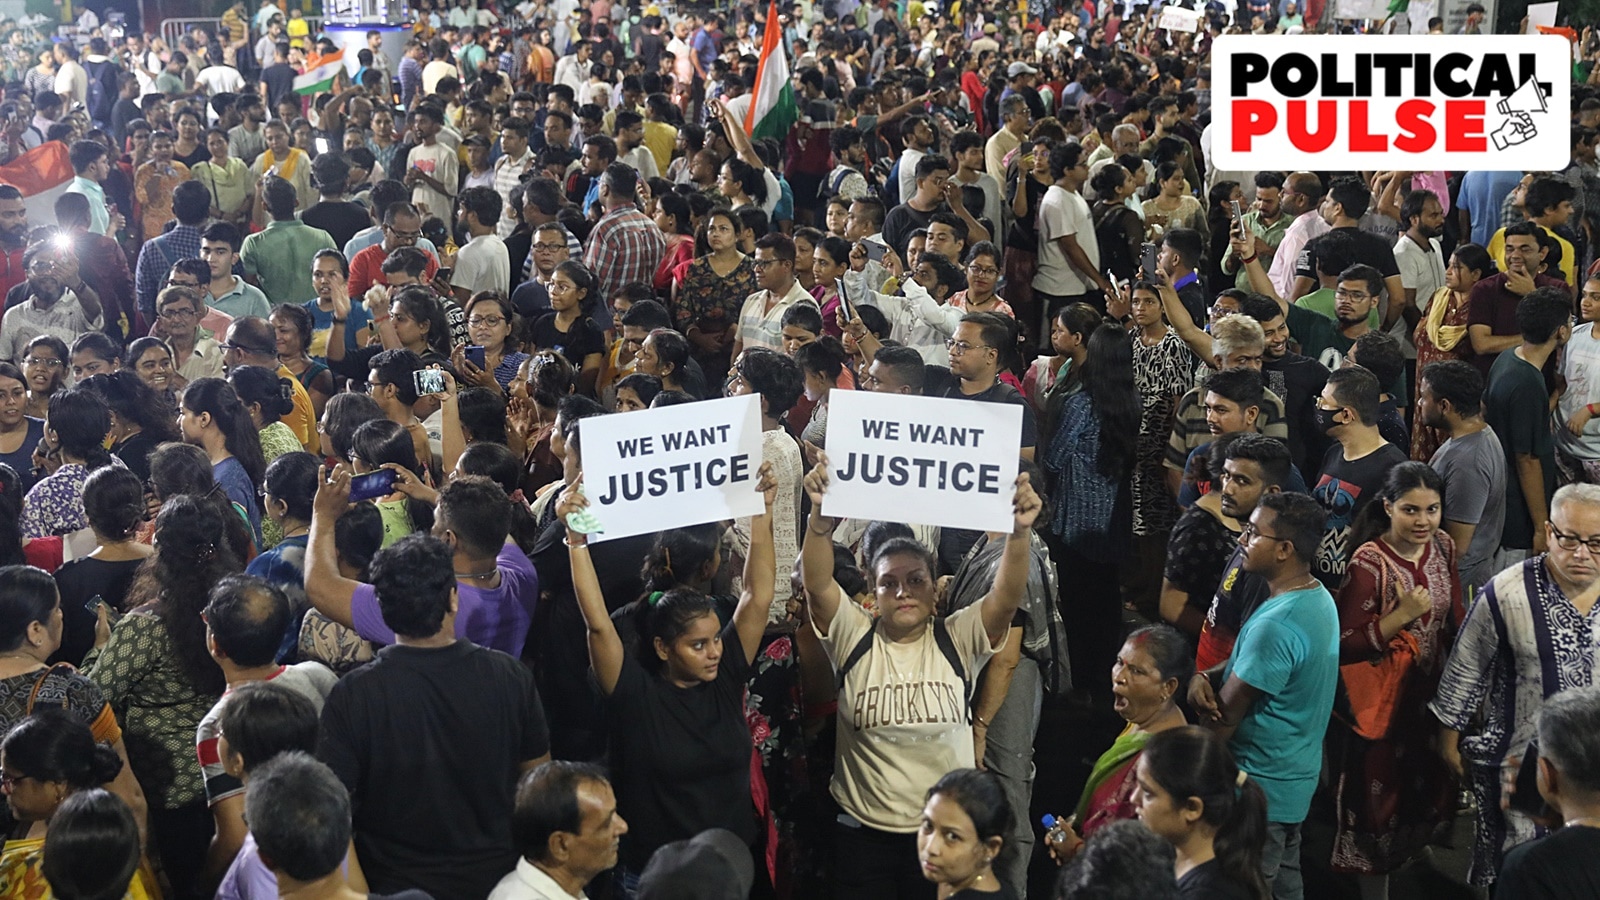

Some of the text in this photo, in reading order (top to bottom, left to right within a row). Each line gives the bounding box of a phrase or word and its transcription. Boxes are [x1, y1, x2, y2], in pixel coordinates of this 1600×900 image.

[617, 425, 731, 459] WE WANT
[863, 419, 984, 448] WE WANT
[598, 453, 750, 506] JUSTICE
[836, 452, 1000, 494] JUSTICE
[853, 681, 962, 732] BROOKLYN
